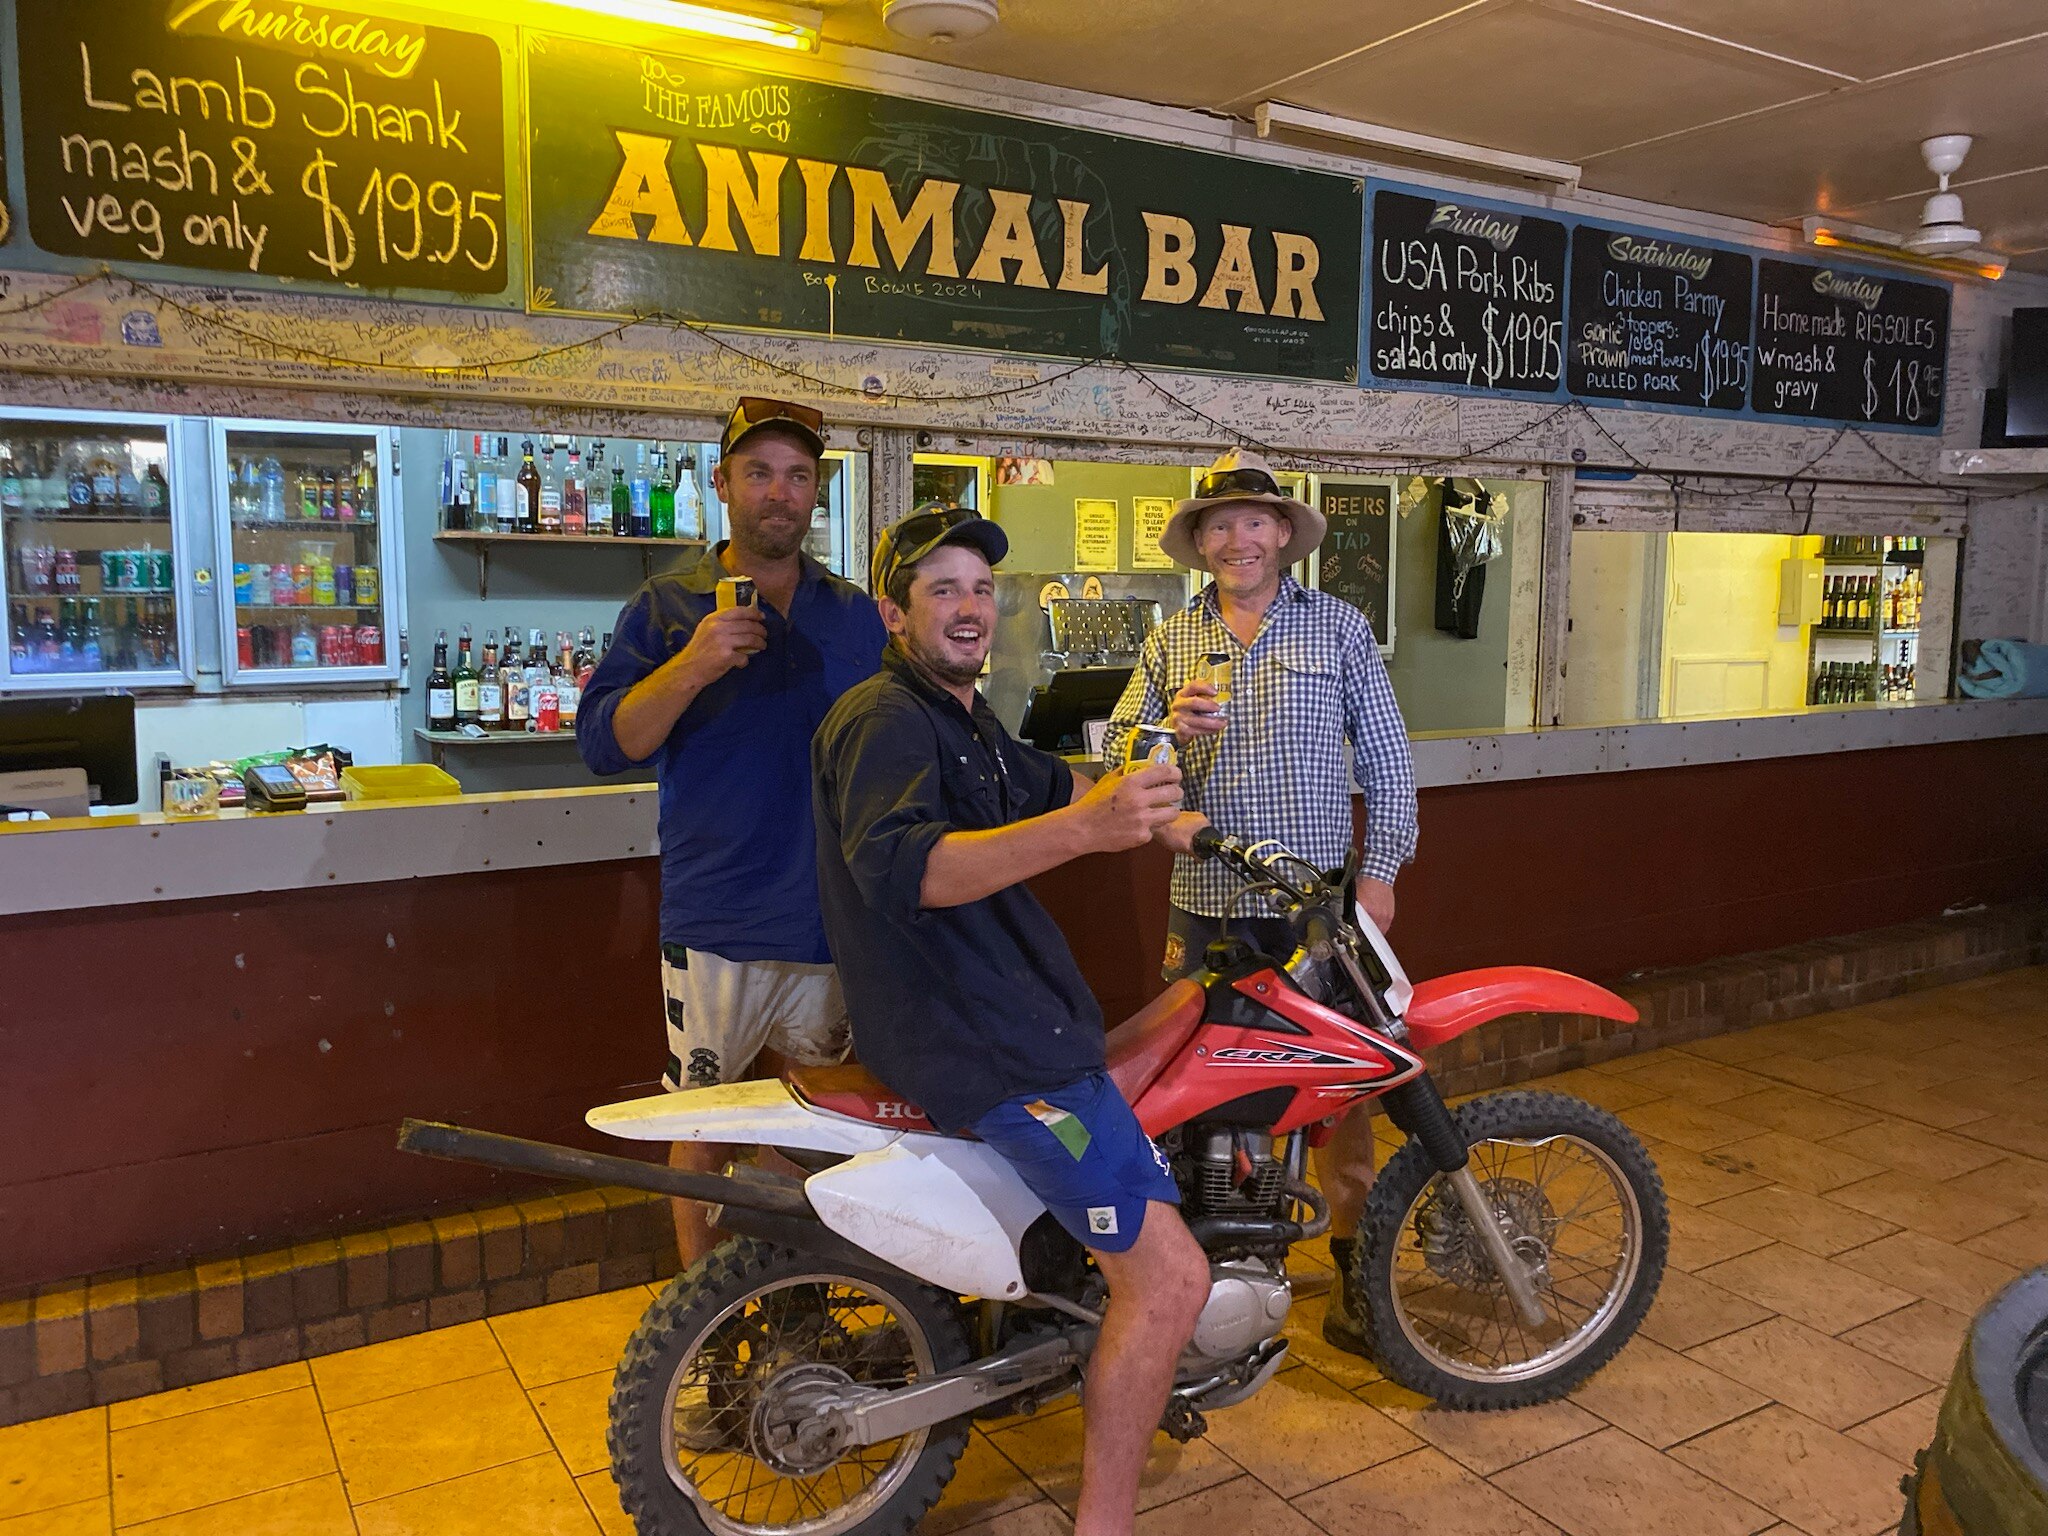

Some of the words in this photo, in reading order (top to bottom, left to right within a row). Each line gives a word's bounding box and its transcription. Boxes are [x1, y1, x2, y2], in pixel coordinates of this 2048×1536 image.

[81, 41, 276, 130] Lamb
[295, 62, 468, 153] Shank
[640, 74, 690, 126] THE
[696, 85, 791, 128] FAMOUS
[61, 129, 218, 195] mash
[231, 135, 274, 196] &
[60, 195, 165, 260] veg
[183, 199, 268, 271] only
[587, 130, 1108, 296] ANIMAL
[1140, 211, 1325, 322] BAR
[1430, 205, 1519, 245] Friday
[1382, 239, 1447, 291] USA
[1458, 245, 1507, 298] Pork
[1513, 256, 1554, 303] Ribs
[1607, 236, 1712, 280] Saturday
[932, 282, 982, 299] 2024
[1603, 270, 1662, 309] Chicken
[1675, 275, 1725, 334] Parmy
[1812, 270, 1884, 310] Sunday
[1377, 301, 1434, 348] chips
[1438, 303, 1455, 337] &
[1582, 321, 1623, 345] Garlic
[1616, 311, 1626, 330] 3
[1856, 311, 1935, 349] RISSOLES
[1377, 335, 1437, 371] salad
[1442, 341, 1477, 385] only
[1825, 346, 1836, 373] &
[1587, 372, 1637, 391] PULLED
[1643, 372, 1681, 391] PORK
[1775, 380, 1819, 410] gravy
[1325, 496, 1385, 516] BEERS
[1346, 517, 1357, 527] ON
[1333, 532, 1371, 550] TAP
[1212, 1048, 1321, 1063] CRF
[875, 1101, 927, 1120] HO
